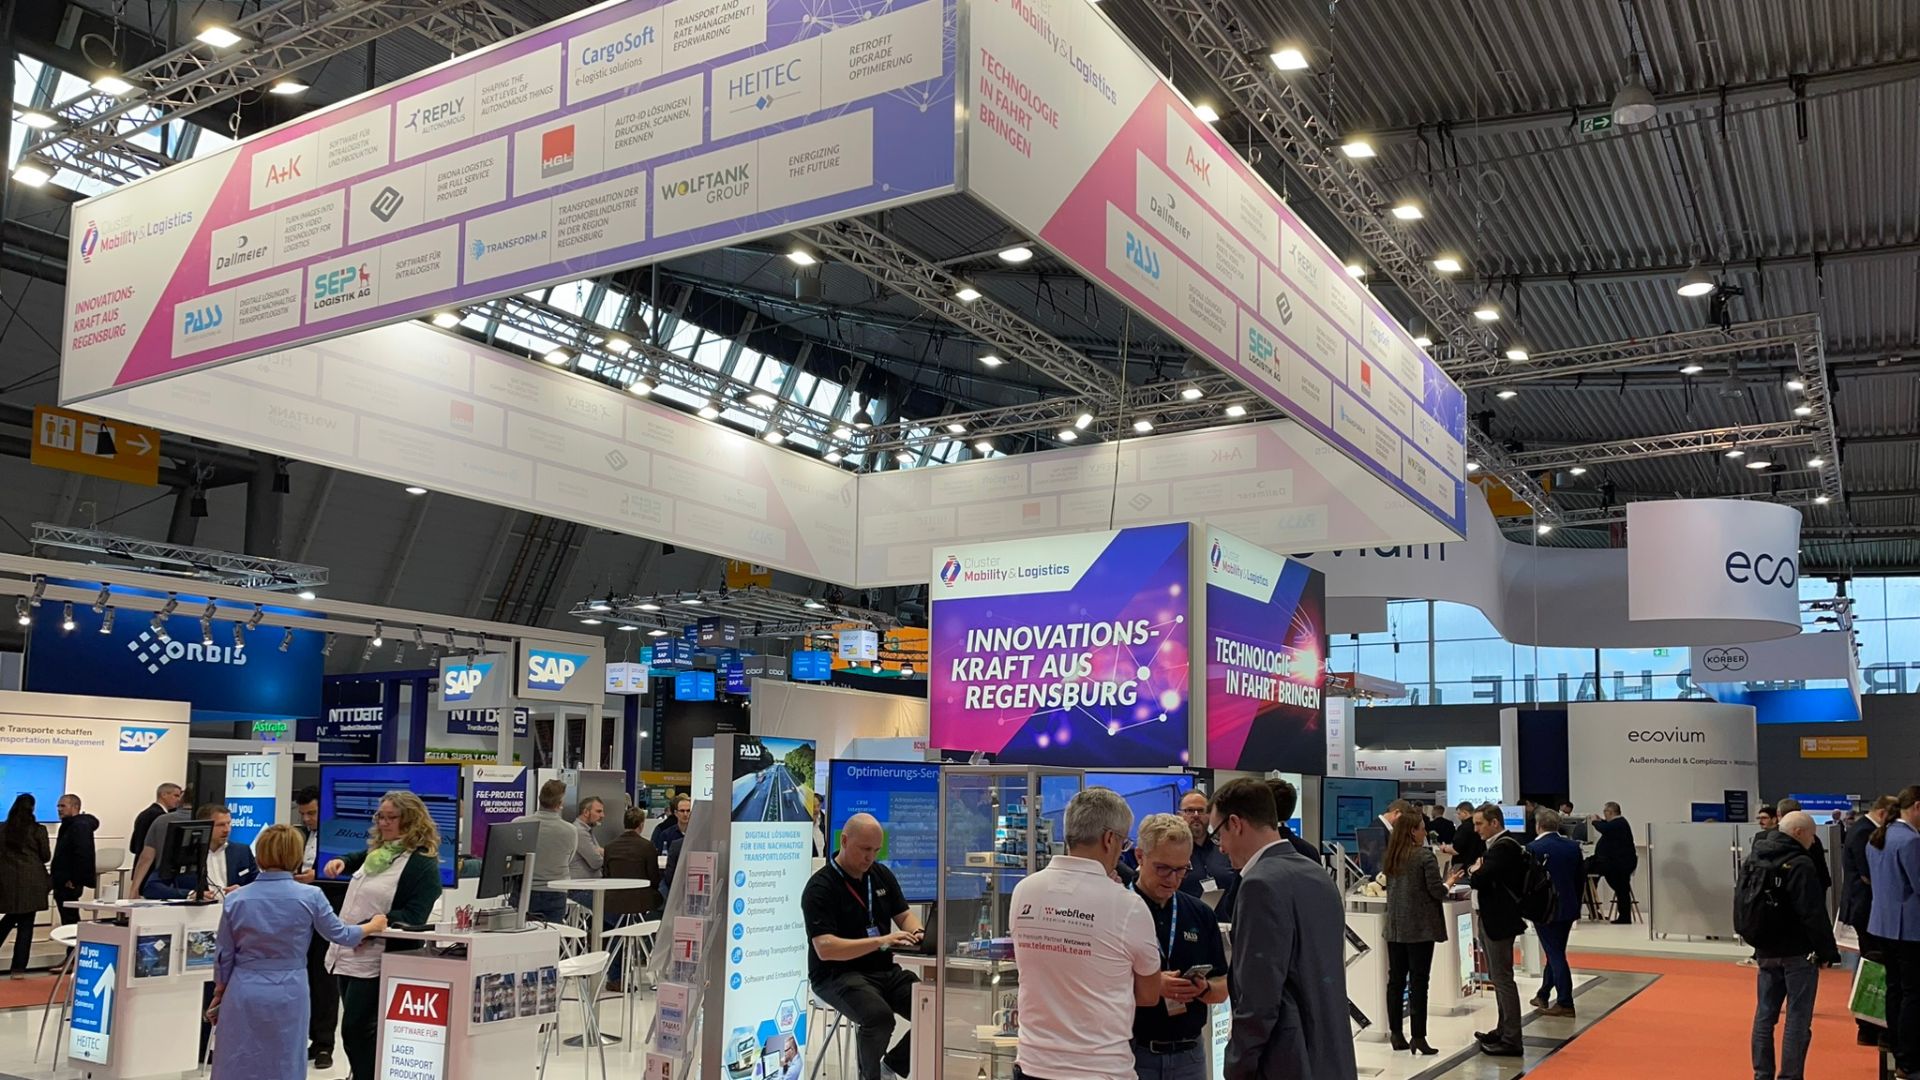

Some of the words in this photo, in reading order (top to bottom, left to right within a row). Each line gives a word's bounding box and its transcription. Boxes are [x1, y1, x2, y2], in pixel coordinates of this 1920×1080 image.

[674, 4, 721, 28] TRANSPORT
[723, 0, 740, 12] AND
[674, 27, 694, 41] RATE
[694, 9, 751, 35] MANAGEMENT
[581, 25, 656, 67] CargoSoft
[673, 25, 731, 52] EFORWARDING
[849, 35, 893, 56] RETROFIT
[848, 54, 913, 81] OPTIMIERUNG
[849, 47, 893, 69] UPGRADE
[575, 66, 607, 88] e-logistic
[608, 57, 643, 77] solutions
[729, 59, 802, 100] HEITEC
[481, 79, 510, 95] SHAPING
[512, 73, 525, 85] THE
[481, 93, 499, 107] NEXT
[499, 87, 519, 101] LEVEL
[519, 83, 528, 94] OF
[980, 47, 1060, 130] TECHNOLOGIE
[422, 96, 465, 125] REPLY
[481, 94, 528, 116] AUTONOMOUS
[528, 85, 554, 104] THINGS
[980, 75, 994, 101] IN
[995, 88, 1033, 132] FAHRT
[615, 111, 646, 127] AUTO-ID
[647, 97, 688, 119] LÖSUNGEN
[421, 114, 466, 135] AUTONOMOUS
[979, 103, 1032, 160] BRINGEN
[614, 130, 654, 150] ERKENNEN
[543, 153, 572, 169] HGL
[788, 144, 840, 167] ENERGIZING
[1185, 145, 1211, 188] A+K
[265, 154, 302, 188] A+K
[437, 166, 461, 182] EIKONA
[789, 166, 805, 178] THE
[806, 156, 840, 175] FUTURE
[448, 175, 464, 190] FULL
[464, 168, 490, 186] SERVICE
[661, 163, 750, 200] WOLFTANK
[436, 187, 468, 203] PROVIDER
[558, 189, 623, 215] TRANSFORMATION
[623, 186, 639, 198] DER
[706, 182, 750, 205] GROUP
[304, 216, 322, 230] VIDEO
[558, 198, 638, 227] AUTOMOBILINDUSTRIE
[1150, 195, 1191, 241] Dallmeier
[284, 227, 319, 244] TECHNOLOGY
[319, 223, 331, 234] FOR
[558, 227, 566, 237] IN
[566, 222, 581, 236] DER
[581, 216, 609, 232] REGION
[557, 228, 604, 249] REGENSBURG
[216, 246, 268, 270] Dallmeier
[395, 255, 428, 270] SOFTWARE
[428, 250, 441, 263] FÜR
[314, 265, 357, 299] SEP
[395, 262, 441, 280] INTRALOGISTIK
[75, 285, 136, 315] INNOVATIONS-
[313, 291, 355, 310] LOGISTIK
[357, 287, 371, 300] AG
[73, 313, 101, 332] KRAFT
[101, 307, 119, 323] AUS
[72, 323, 126, 350] REGENSBURG
[1248, 327, 1273, 362] SEP
[964, 555, 1000, 569] Cluster
[966, 619, 1160, 653] INNOVATIONS-
[165, 640, 248, 666] ORBIS
[1215, 636, 1291, 677] TECHNOLOGIE
[529, 655, 576, 684] SAP
[951, 655, 1034, 682] KRAFT
[1039, 651, 1093, 680] AUS
[445, 669, 482, 696] SAP
[1226, 668, 1239, 695] IN
[1241, 672, 1276, 702] FAHRT
[1277, 680, 1321, 711] BRINGEN
[965, 680, 1138, 710] REGENSBURG
[8, 724, 55, 735] Transporte
[56, 728, 93, 736] schaffen
[120, 730, 158, 747] SAP
[1627, 726, 1706, 743] ecovium
[51, 738, 105, 748] Management
[739, 744, 761, 757] PASS
[232, 762, 271, 778] HEITEC
[1629, 756, 1682, 765] Außenhandel
[1689, 757, 1728, 766] Compliance
[475, 790, 524, 799] F&E-PROJEKTE
[1459, 784, 1476, 793] The
[1477, 785, 1499, 793] next
[237, 804, 253, 815] you
[740, 841, 752, 850] FÜR
[753, 842, 766, 850] EINE
[767, 841, 804, 850] NACHHALTIGE
[744, 831, 770, 840] DIGITALE
[771, 829, 801, 839] LÖSUNGEN
[744, 852, 801, 862] TRANSPORTLOGISTIK
[1055, 907, 1096, 922] webfleet
[80, 945, 88, 955] All
[88, 949, 100, 959] you
[1063, 937, 1092, 947] Netzwerk
[78, 959, 93, 969] need
[399, 990, 439, 1019] A+K
[76, 1034, 100, 1051] HEITEC
[393, 1025, 425, 1036] SOFTWARE
[426, 1029, 439, 1038] FÜR
[391, 1044, 415, 1055] LAGER
[389, 1067, 436, 1080] PRODUKTION
[391, 1055, 433, 1071] TRANSPORT
